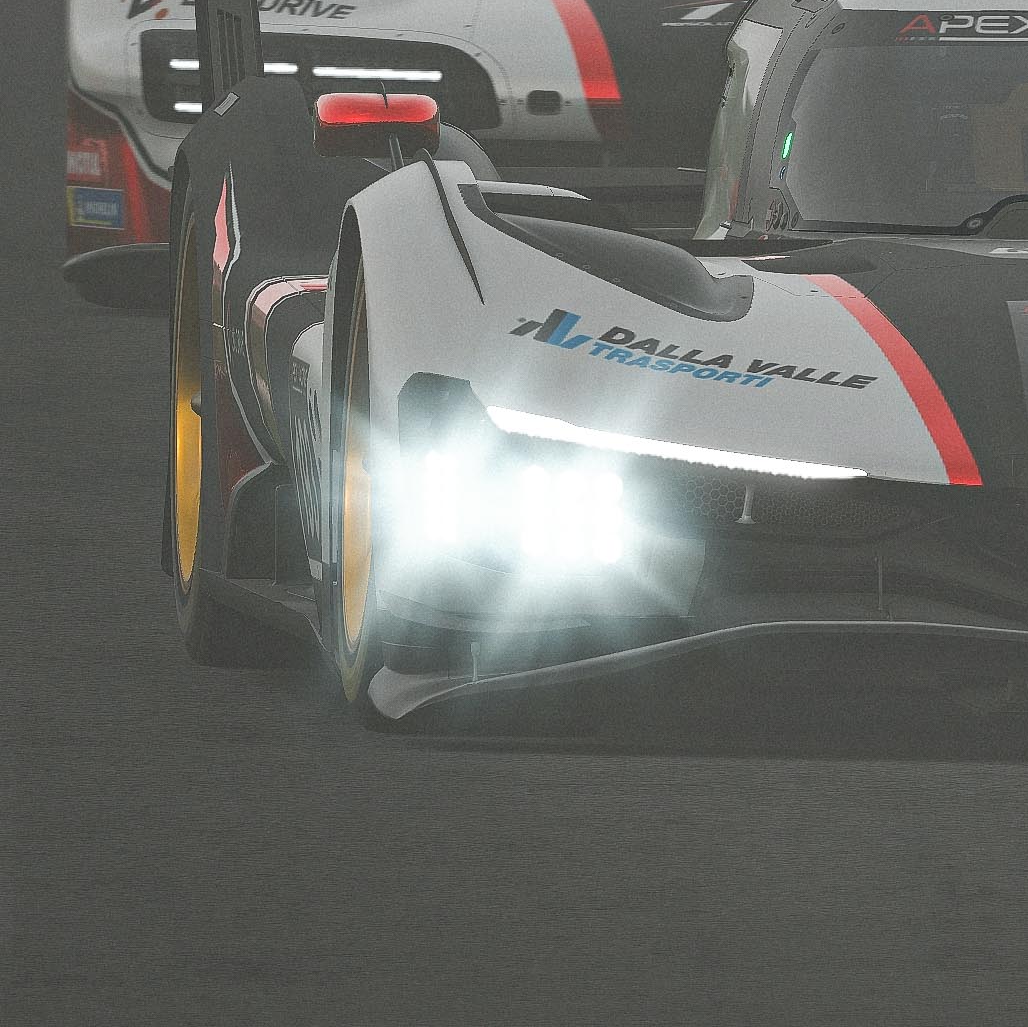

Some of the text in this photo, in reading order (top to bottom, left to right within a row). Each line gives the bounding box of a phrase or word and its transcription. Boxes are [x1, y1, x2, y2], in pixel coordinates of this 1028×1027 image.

[589, 342, 777, 388] TRASPORTI
[599, 326, 879, 389] DALLA VALLE
